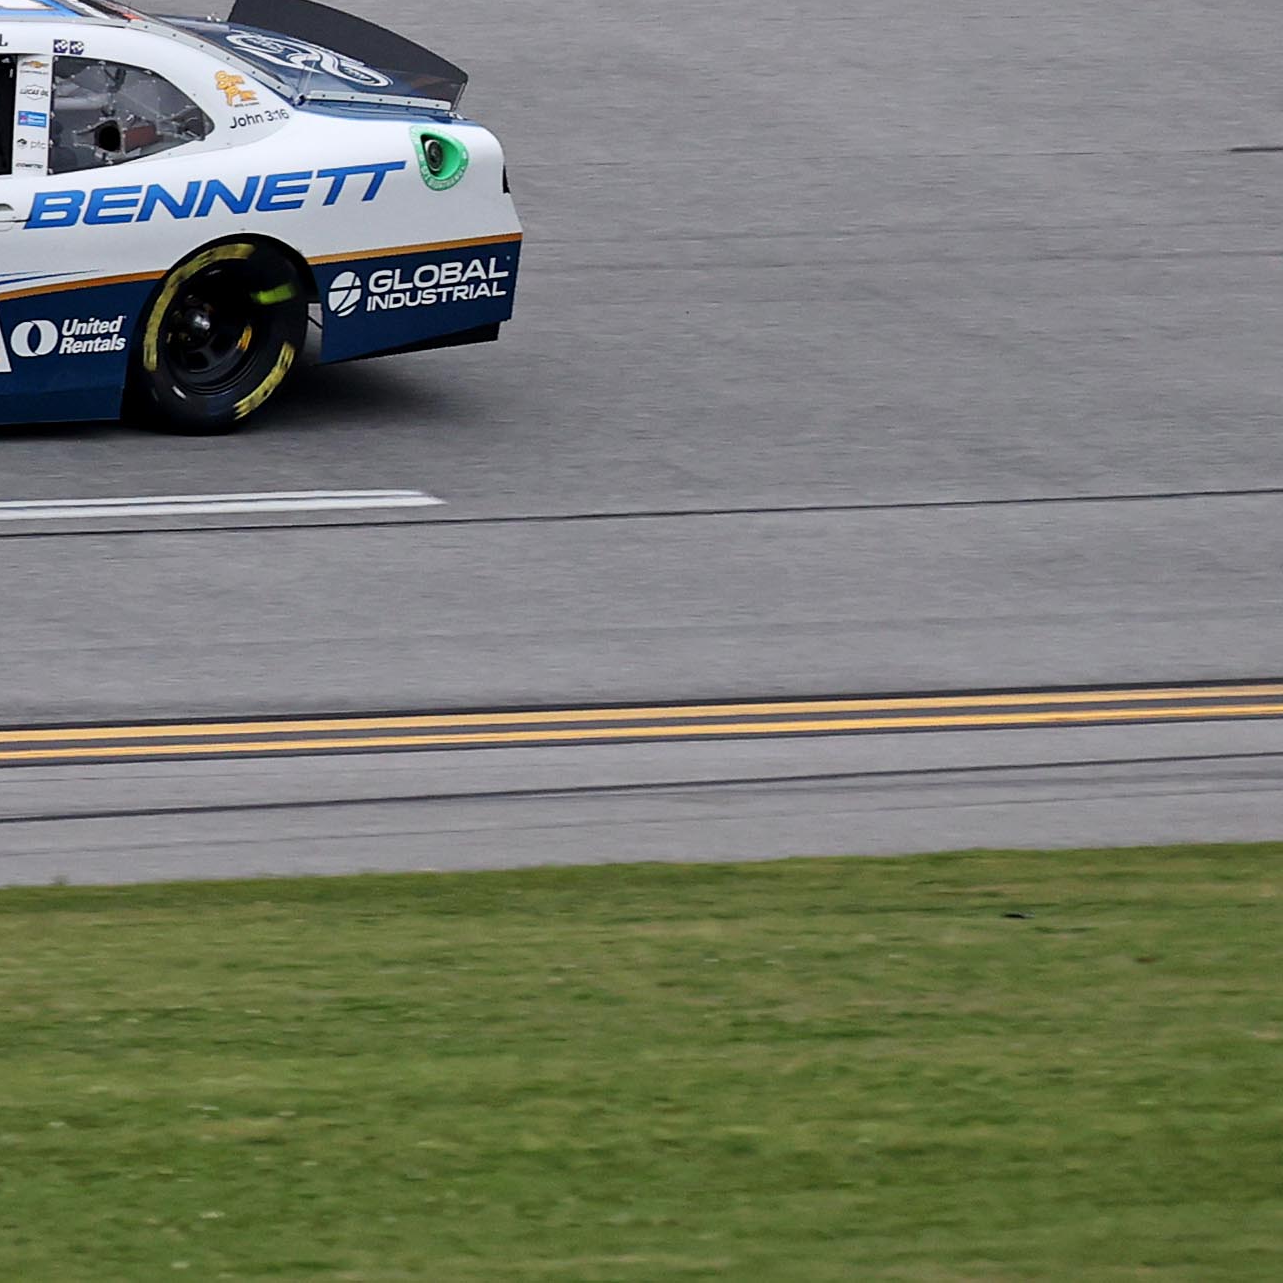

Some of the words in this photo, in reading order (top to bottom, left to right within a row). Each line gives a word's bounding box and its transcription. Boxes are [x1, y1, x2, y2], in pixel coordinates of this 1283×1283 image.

[229, 113, 264, 129] John
[264, 108, 290, 122] 3:16
[23, 160, 406, 229] BENNETT
[368, 257, 509, 293] GLOBAL
[366, 281, 507, 312] INDUSTRIAL
[61, 315, 123, 336] United
[59, 334, 126, 355] Rentals
